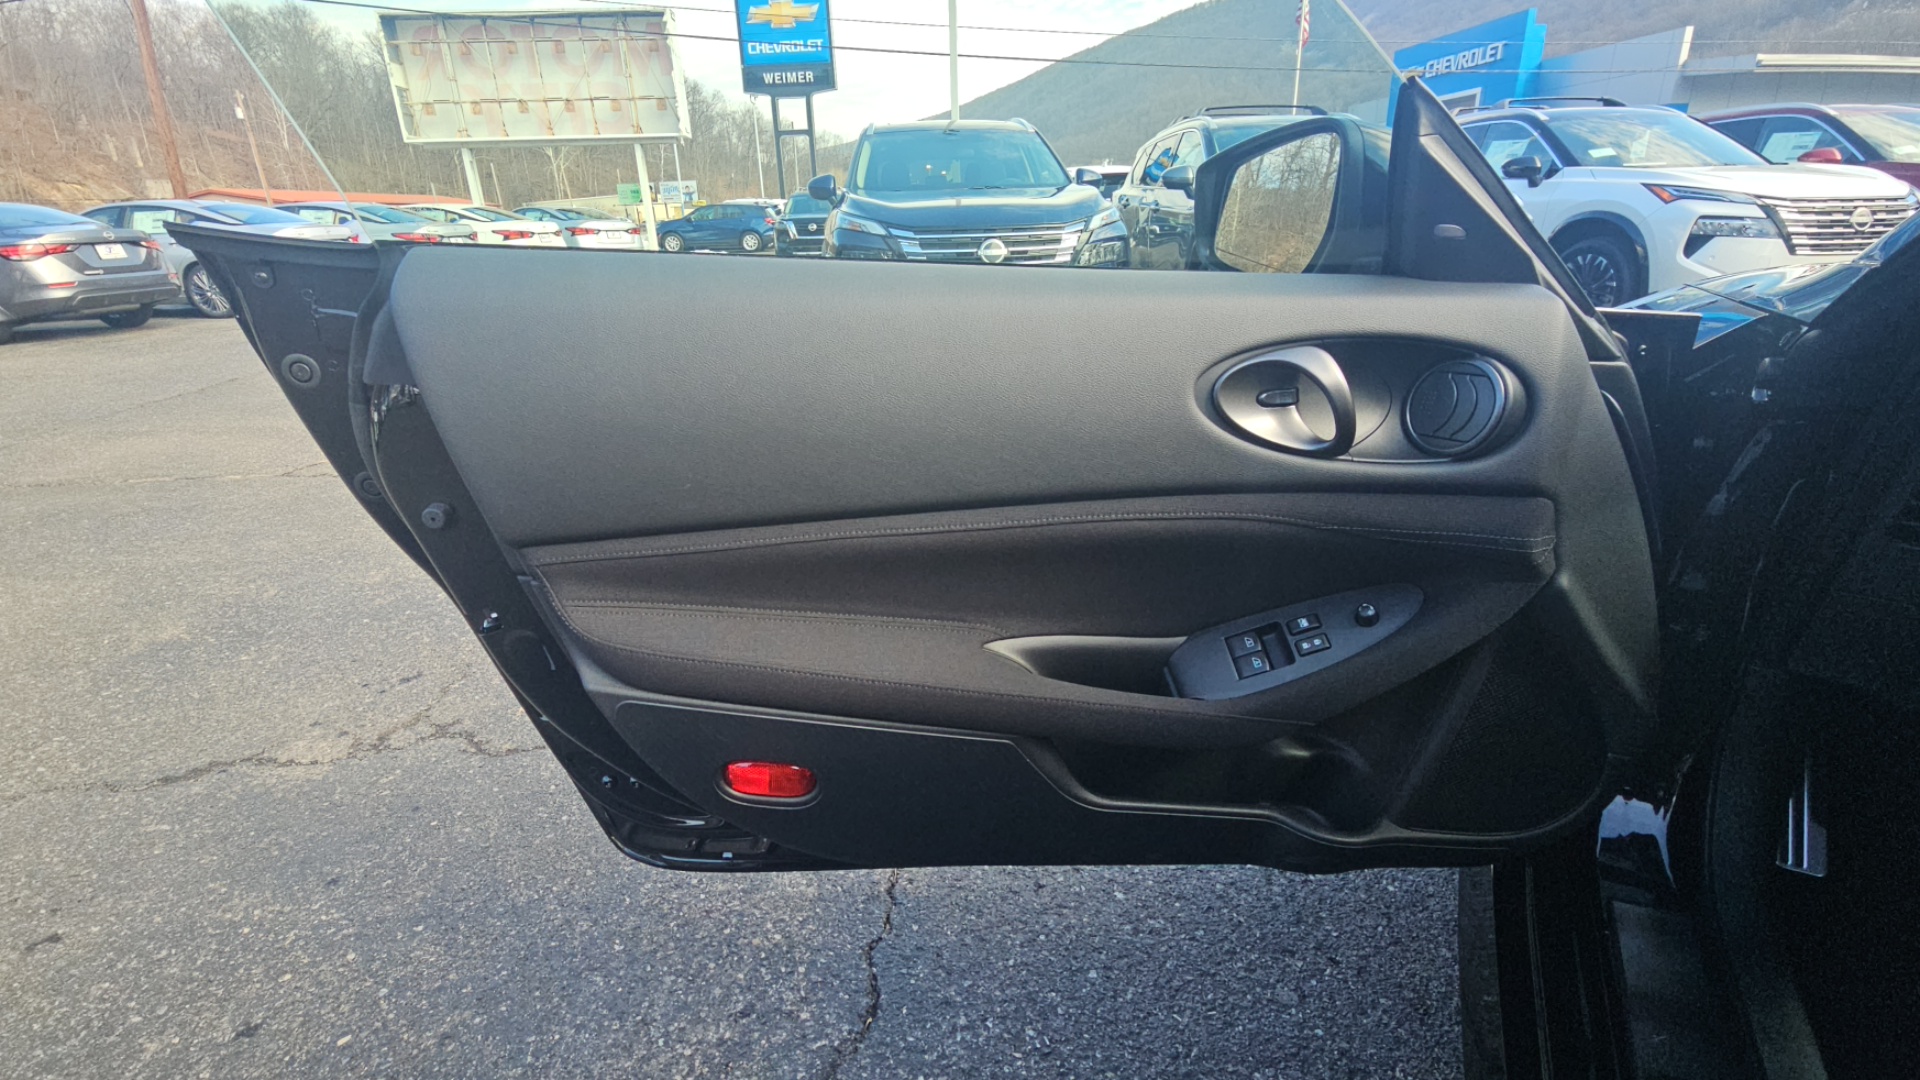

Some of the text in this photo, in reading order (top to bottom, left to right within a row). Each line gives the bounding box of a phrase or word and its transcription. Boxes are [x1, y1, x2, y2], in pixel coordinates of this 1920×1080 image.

[747, 39, 824, 54] CHEVROLET
[1424, 40, 1508, 78] CHEVROLET
[762, 71, 814, 84] WEIMER
